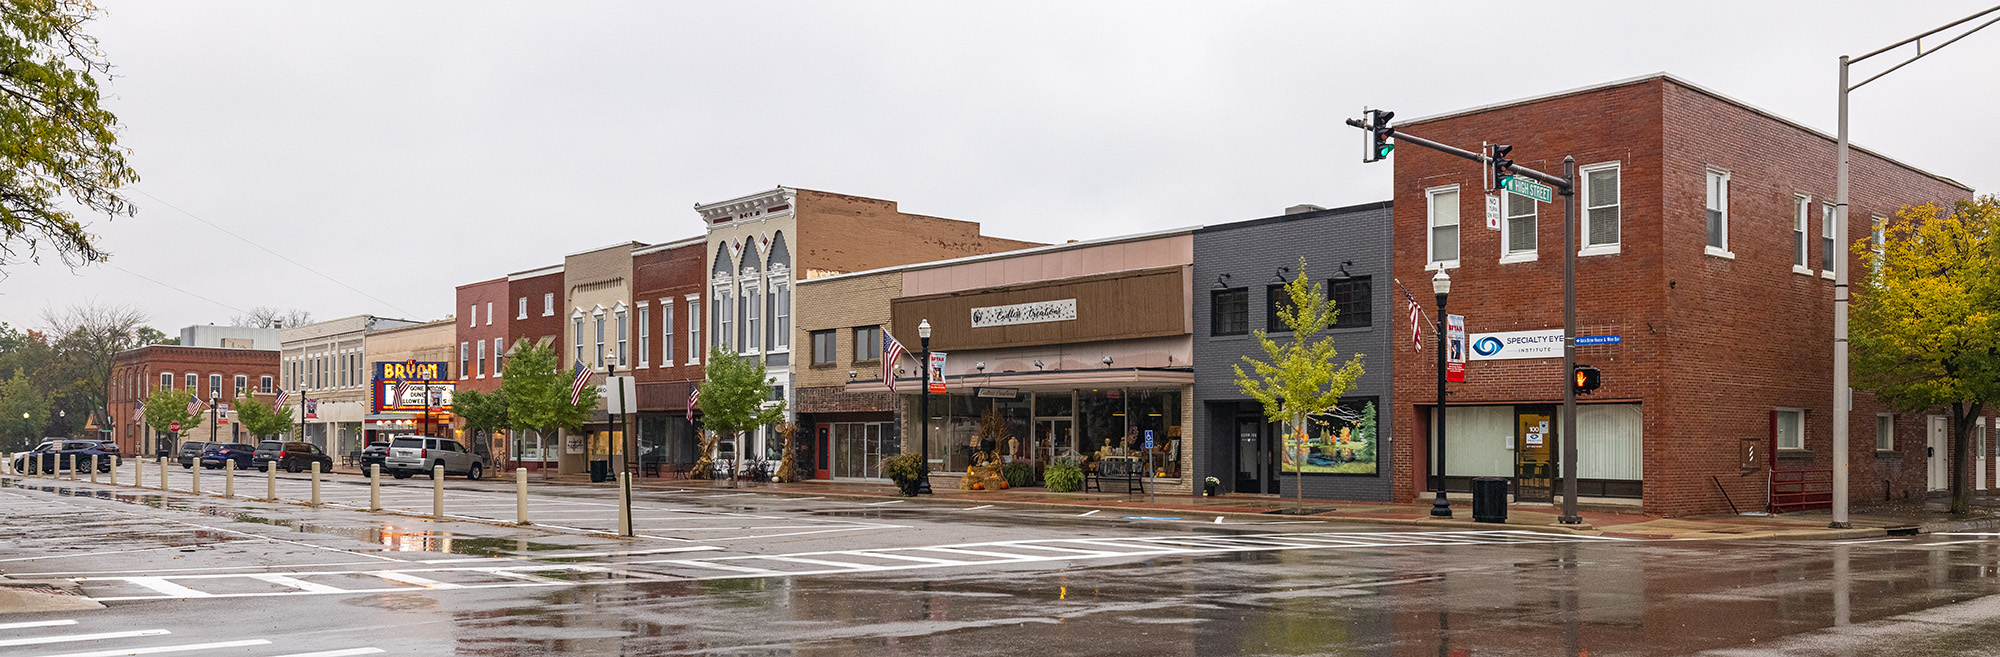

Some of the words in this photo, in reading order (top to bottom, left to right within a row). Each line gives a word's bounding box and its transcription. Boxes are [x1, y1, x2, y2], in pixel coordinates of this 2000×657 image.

[1515, 180, 1528, 194] HIGH
[1530, 184, 1550, 200] STREET
[996, 309, 1020, 320] Endless
[1028, 307, 1060, 318] Creations
[1507, 336, 1547, 344] SPECIALTY
[384, 363, 437, 378] BRYAN
